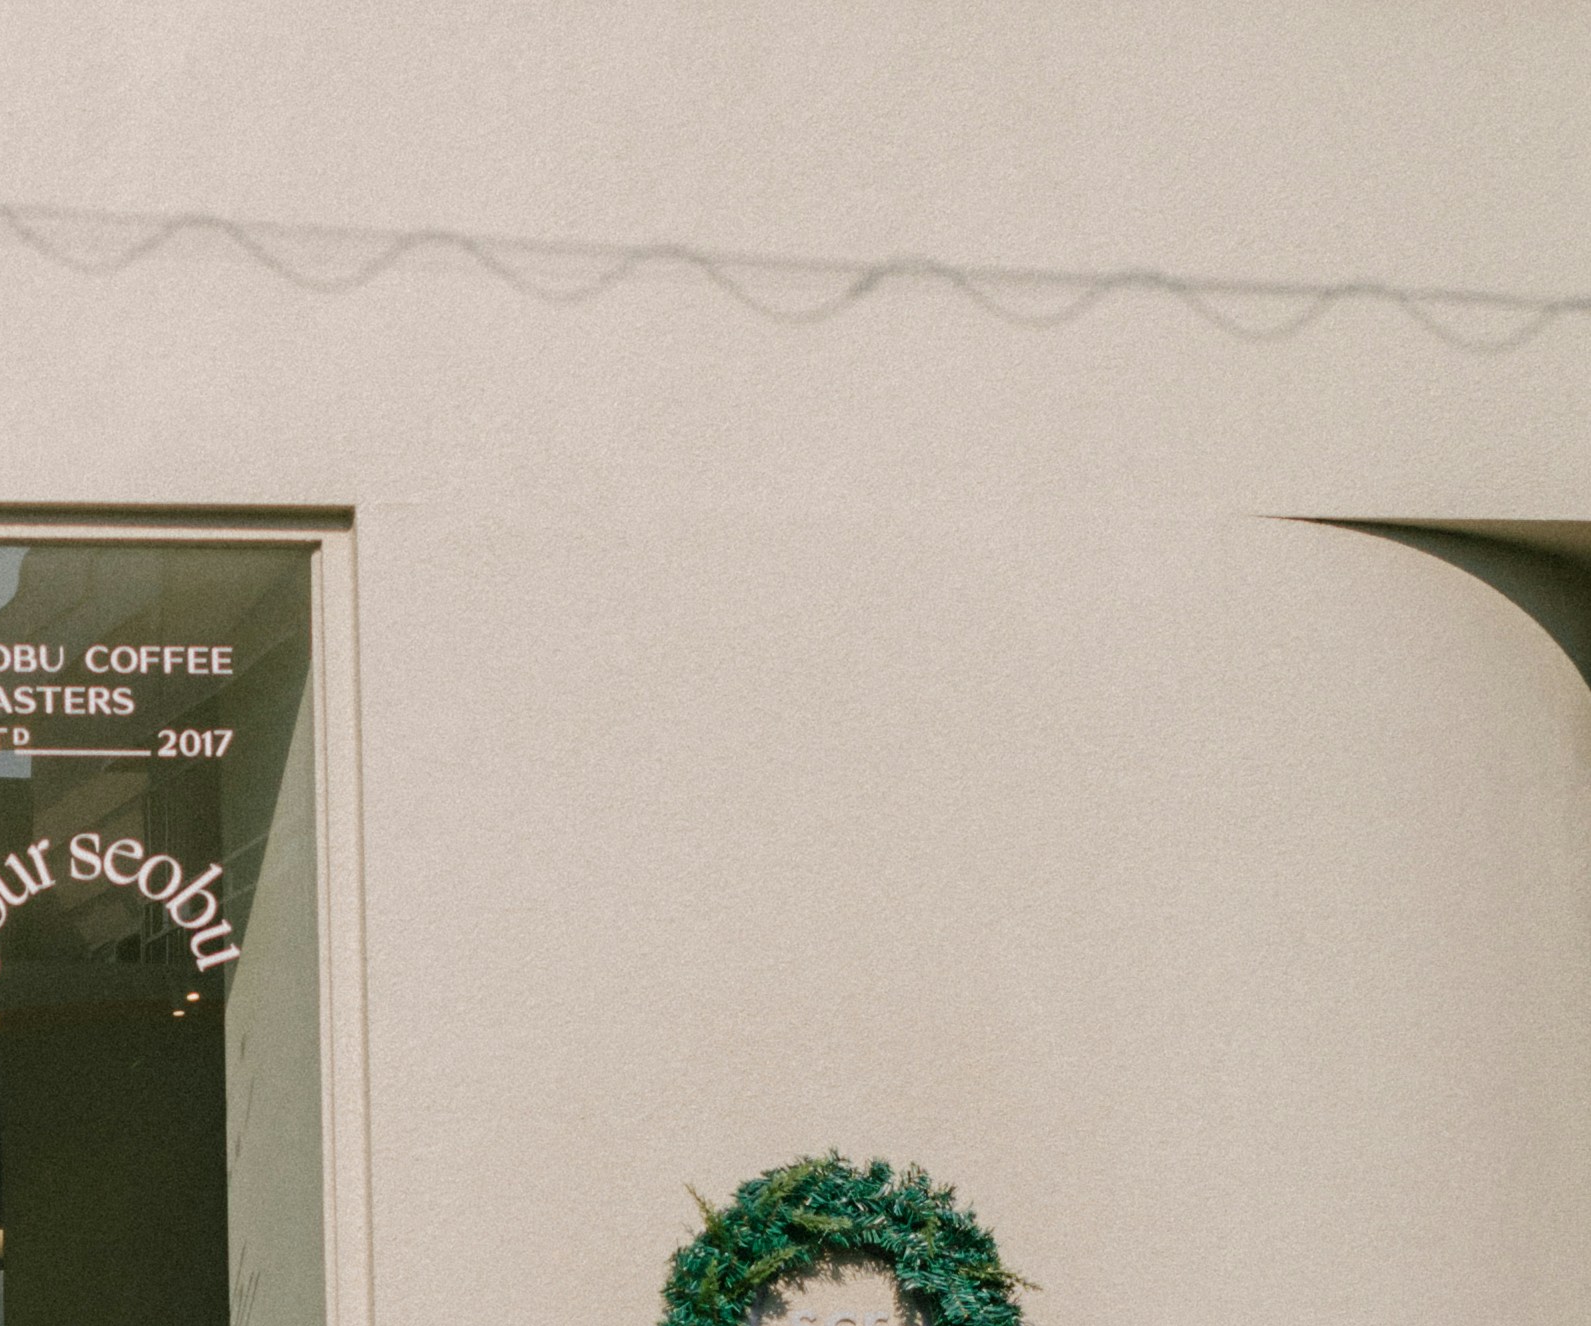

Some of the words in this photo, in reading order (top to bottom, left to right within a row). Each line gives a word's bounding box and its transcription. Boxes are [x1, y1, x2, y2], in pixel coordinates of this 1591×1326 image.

[85, 645, 234, 675] COFFEE
[157, 729, 234, 757] 2017
[69, 832, 241, 972] seobu
